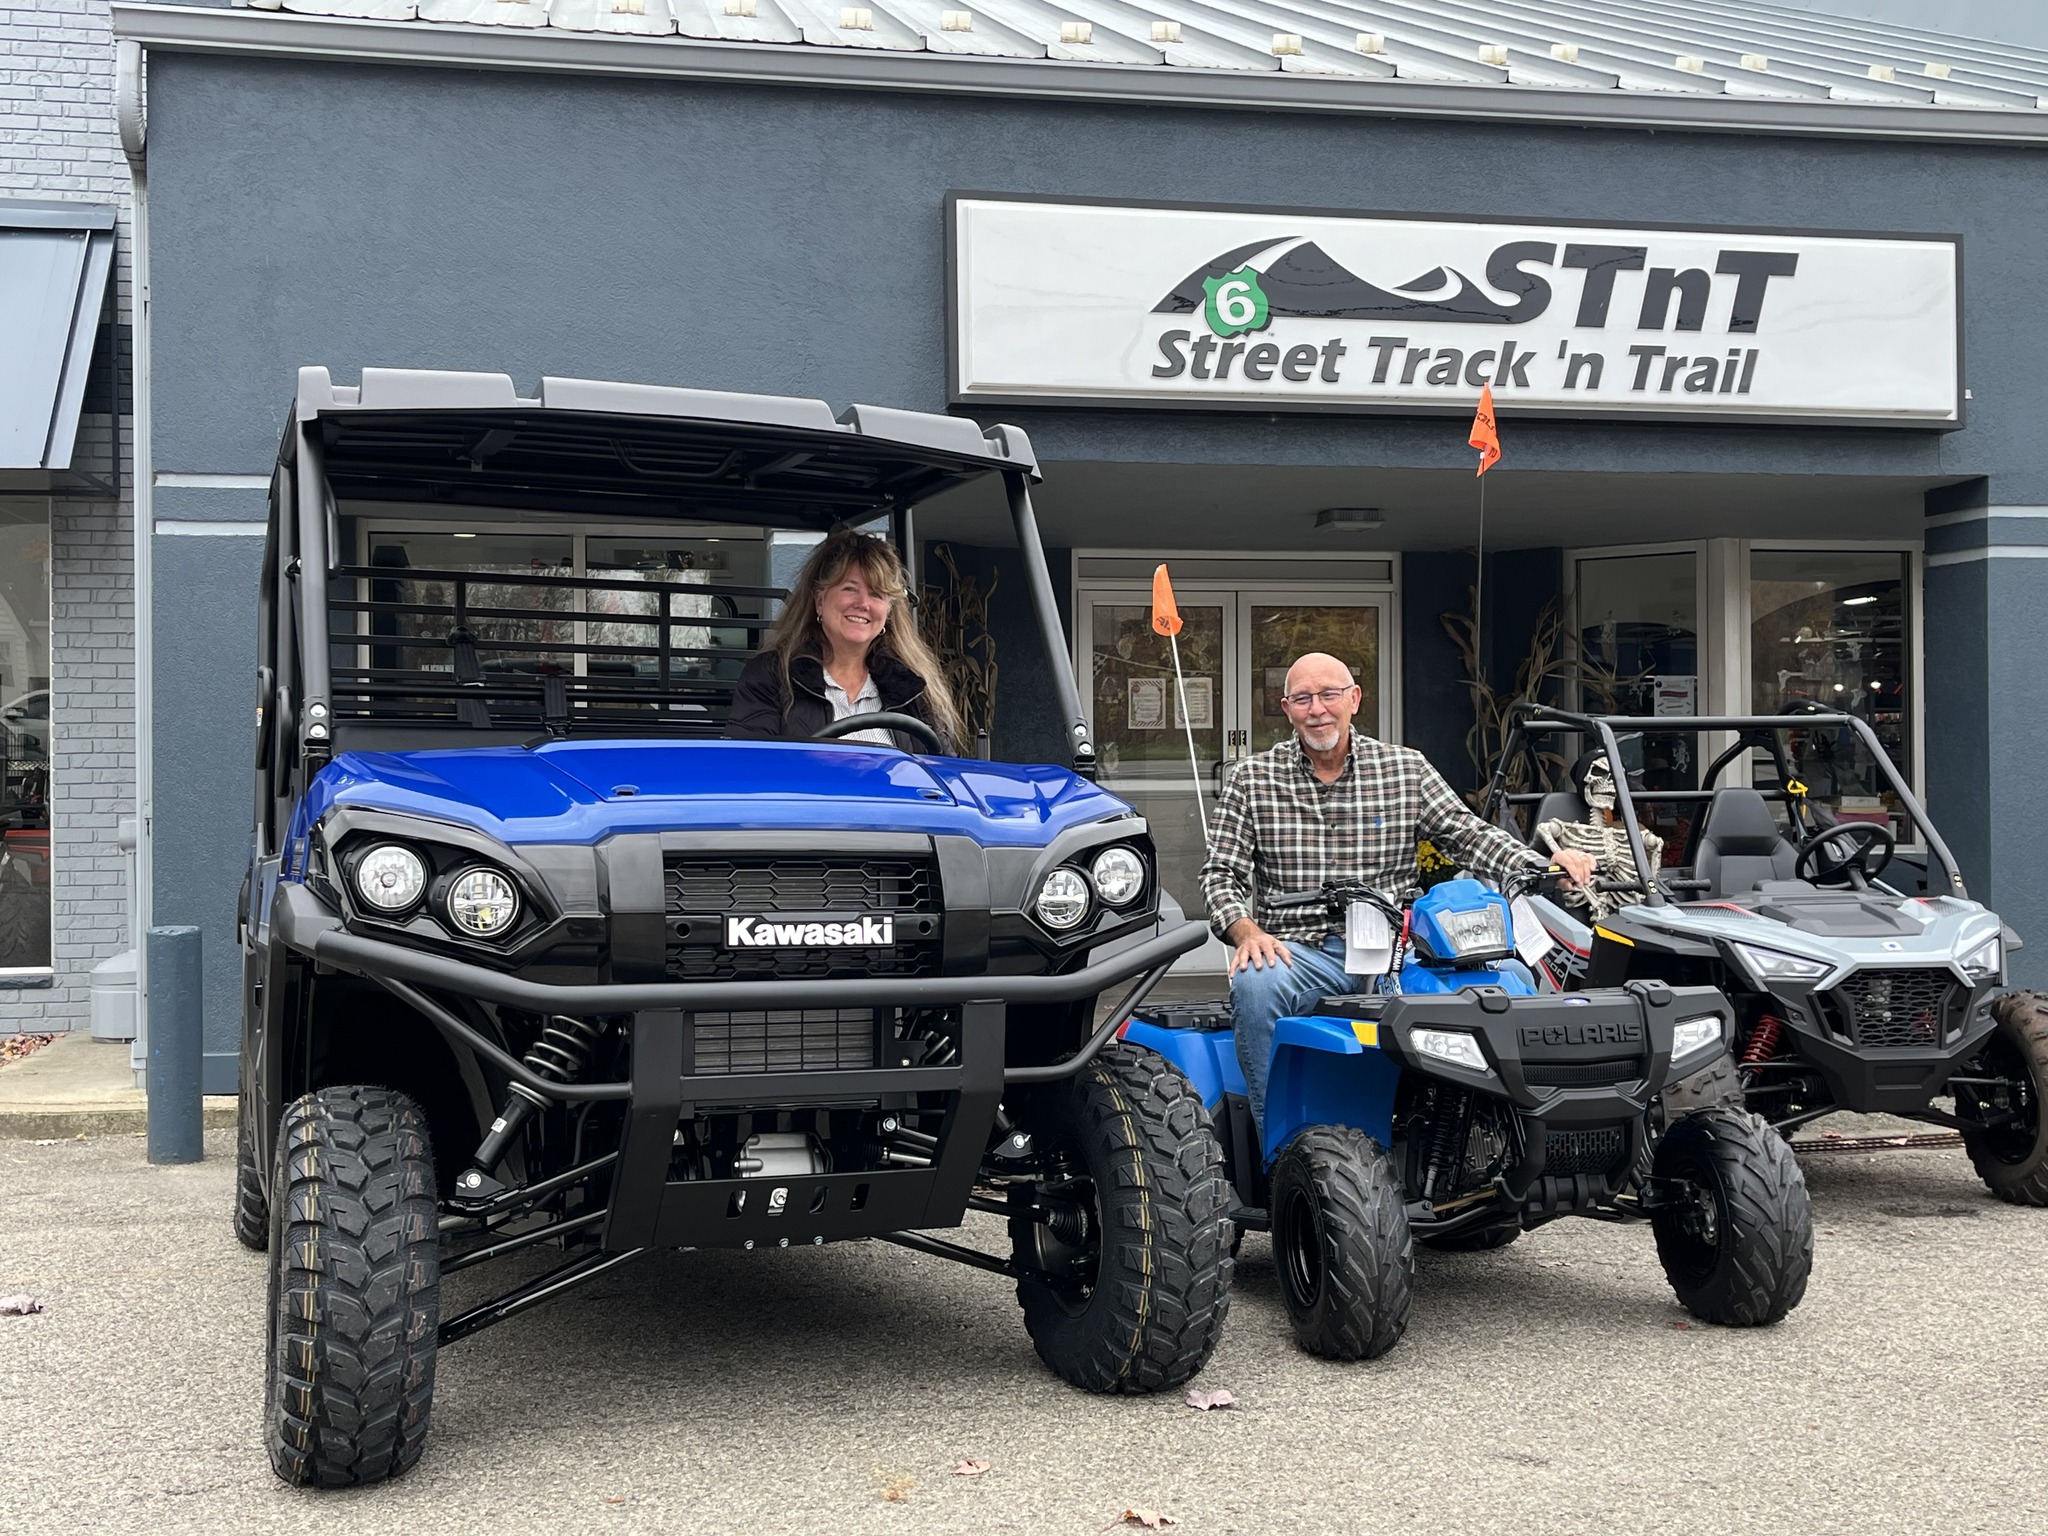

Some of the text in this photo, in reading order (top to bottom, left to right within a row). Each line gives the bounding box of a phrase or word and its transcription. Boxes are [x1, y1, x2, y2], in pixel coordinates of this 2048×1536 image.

[1216, 280, 1257, 327] 6
[1485, 240, 1800, 334] STnT
[1151, 329, 1760, 394] Street Track 'n Trail
[727, 915, 894, 947] Kawasaki
[1521, 1022, 1642, 1047] POLARIS
